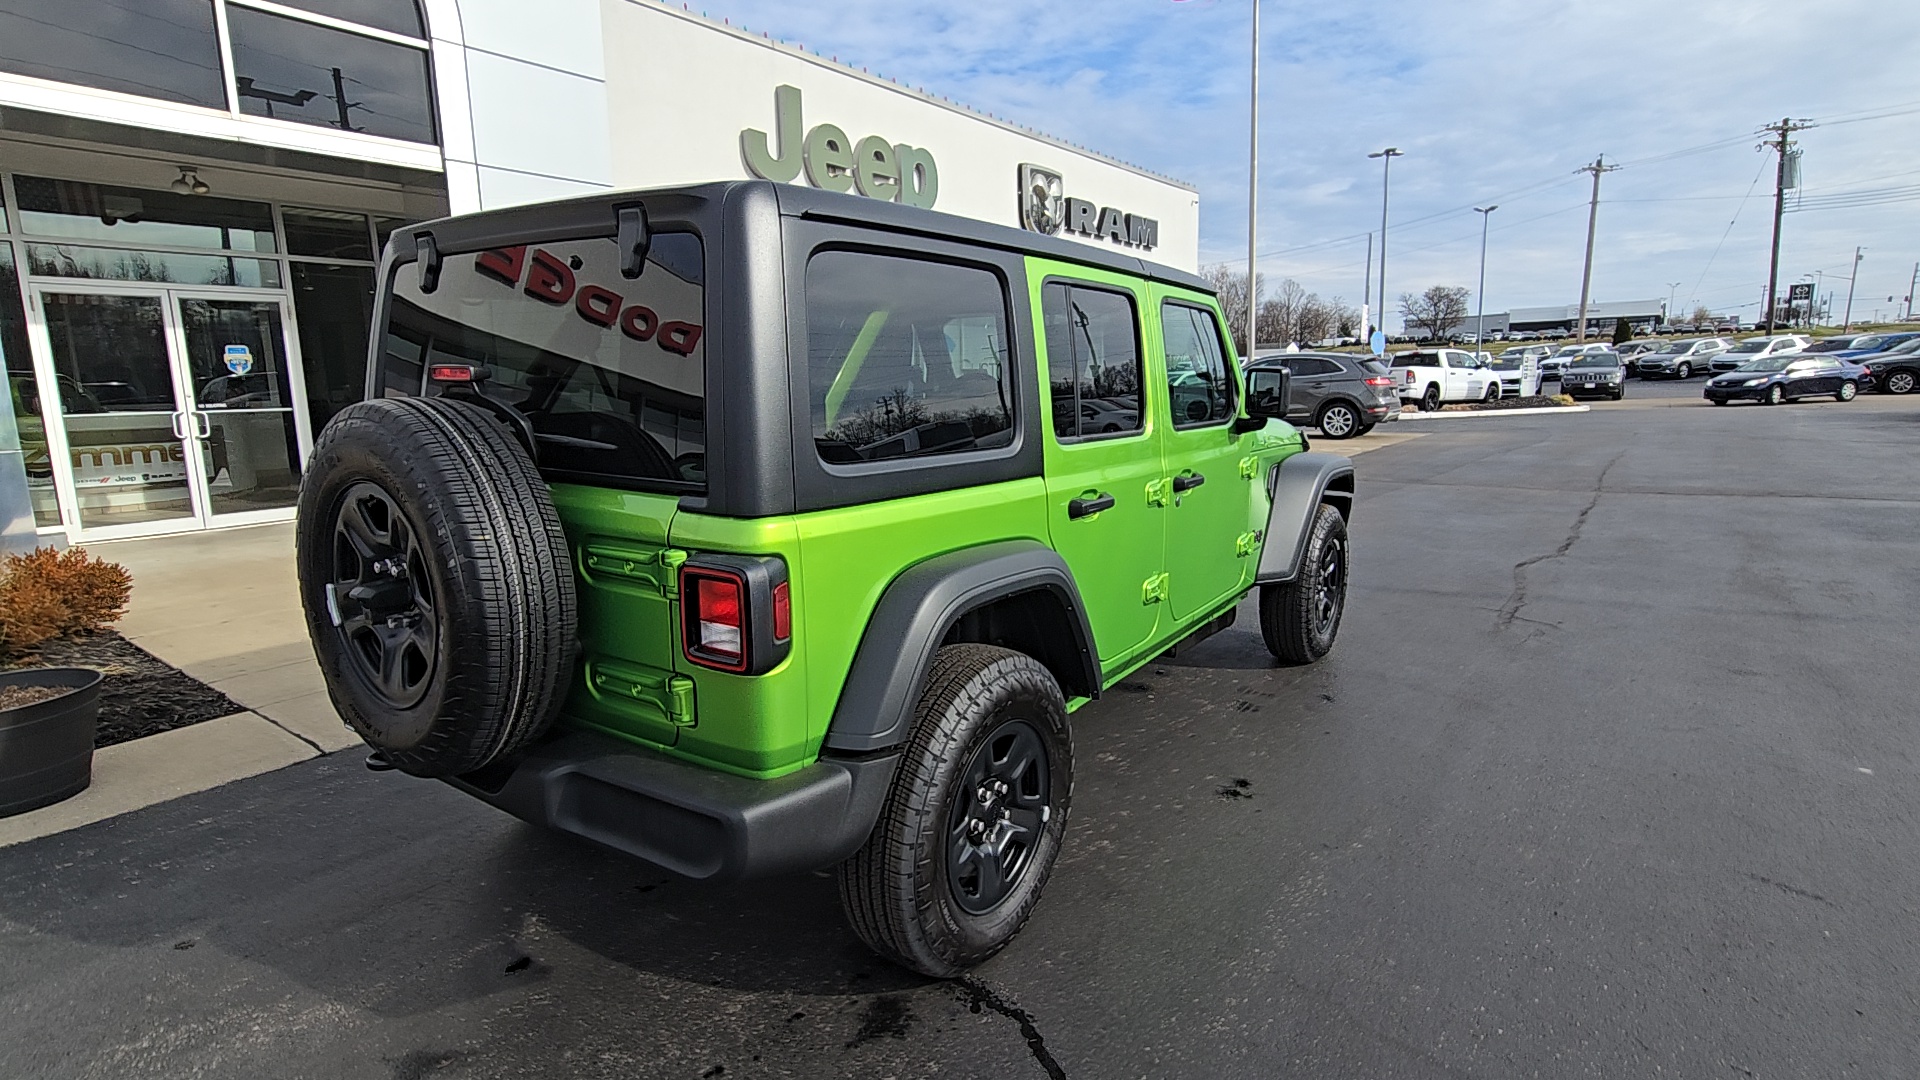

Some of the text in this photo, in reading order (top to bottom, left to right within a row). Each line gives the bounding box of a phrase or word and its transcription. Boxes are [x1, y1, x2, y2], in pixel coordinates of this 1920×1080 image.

[739, 84, 938, 210] Jeep
[1064, 197, 1159, 248] RAM
[24, 442, 210, 469] Zmme
